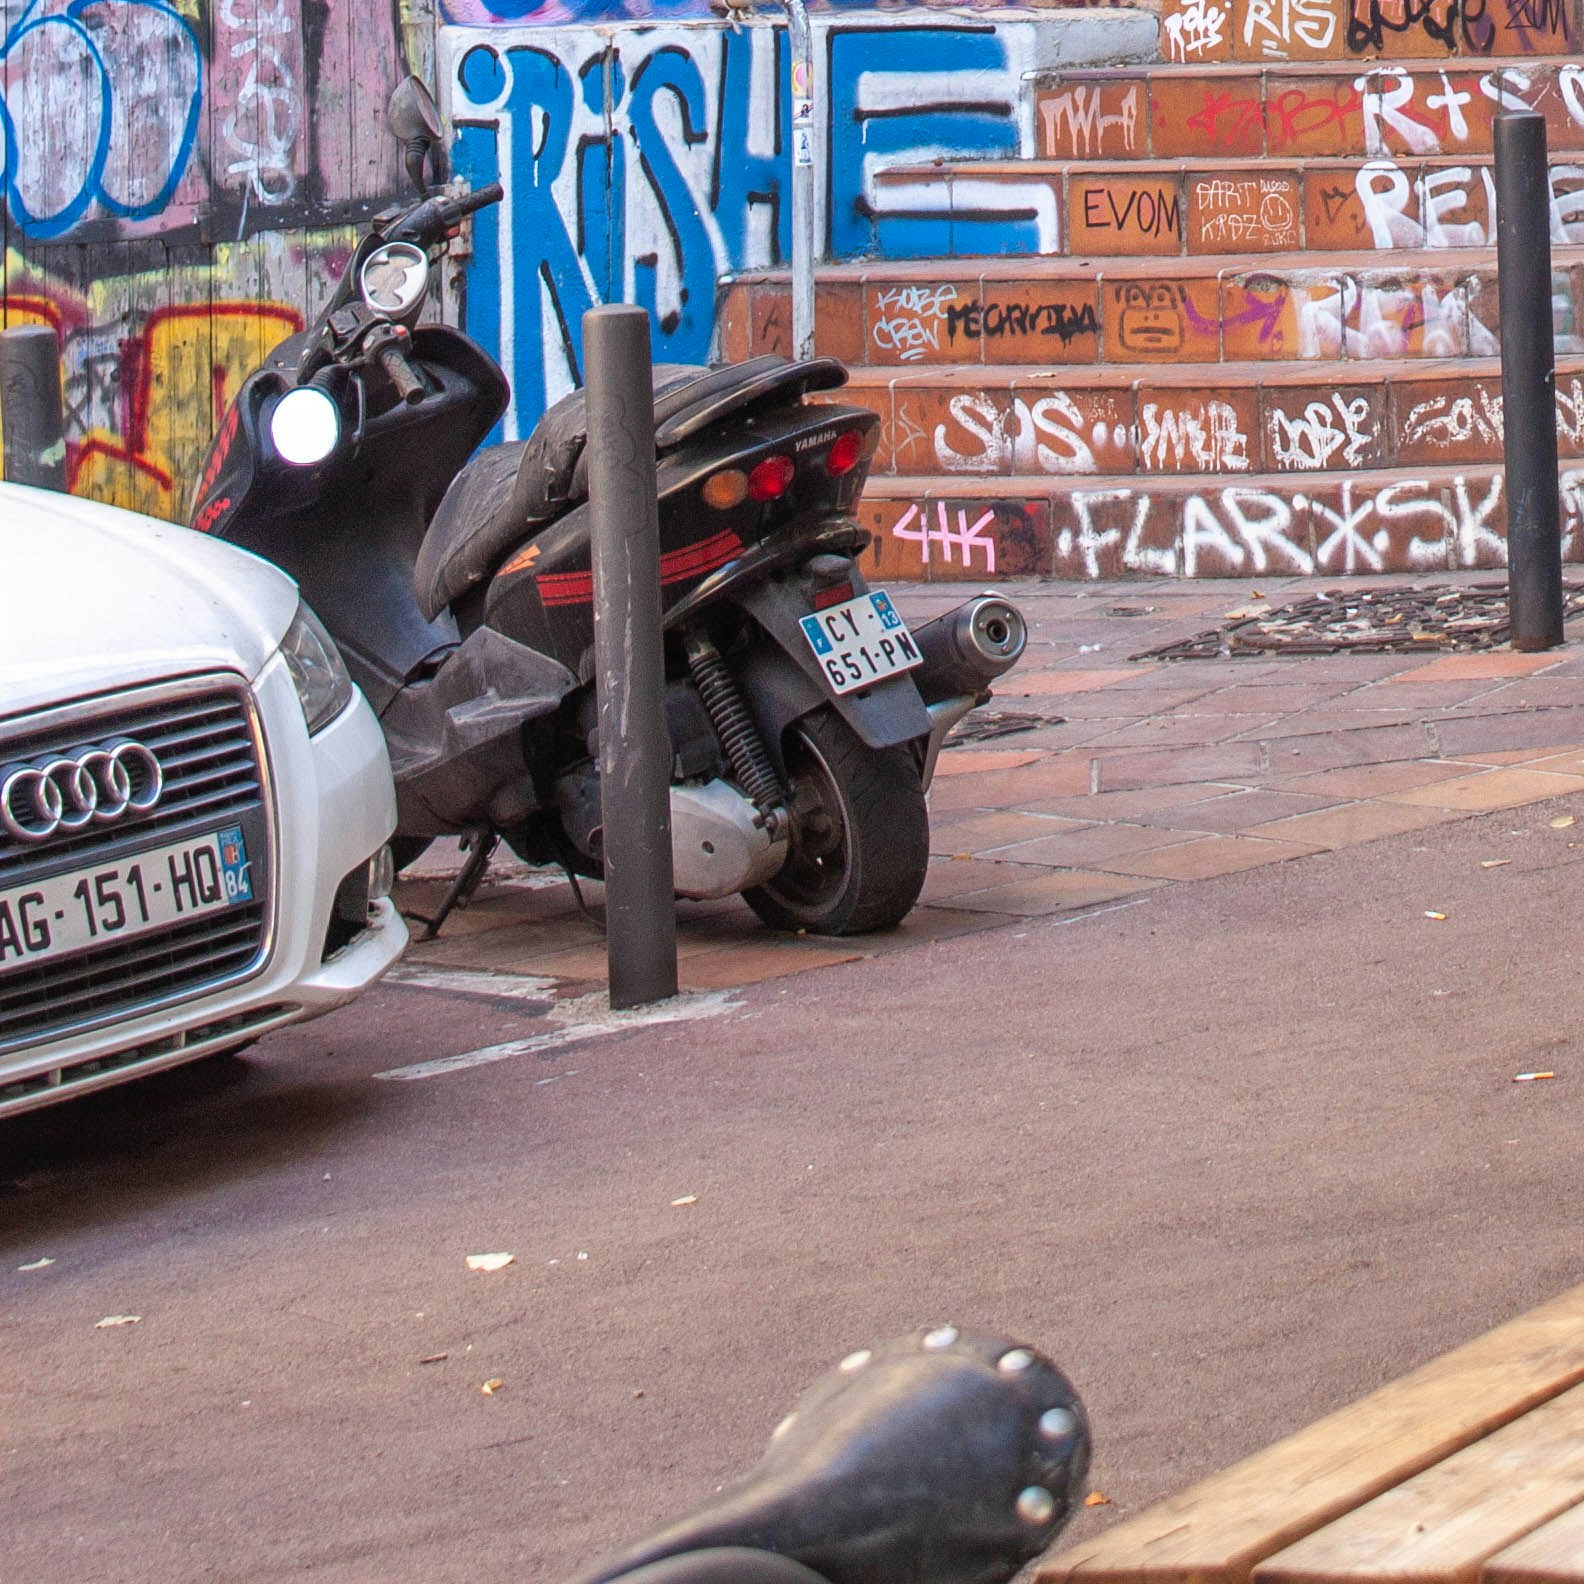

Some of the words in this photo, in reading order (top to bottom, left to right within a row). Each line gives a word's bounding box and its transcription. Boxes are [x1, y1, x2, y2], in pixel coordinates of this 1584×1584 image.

[795, 430, 837, 453] YAMAHA
[881, 610, 899, 627] 13
[225, 868, 250, 898] 84
